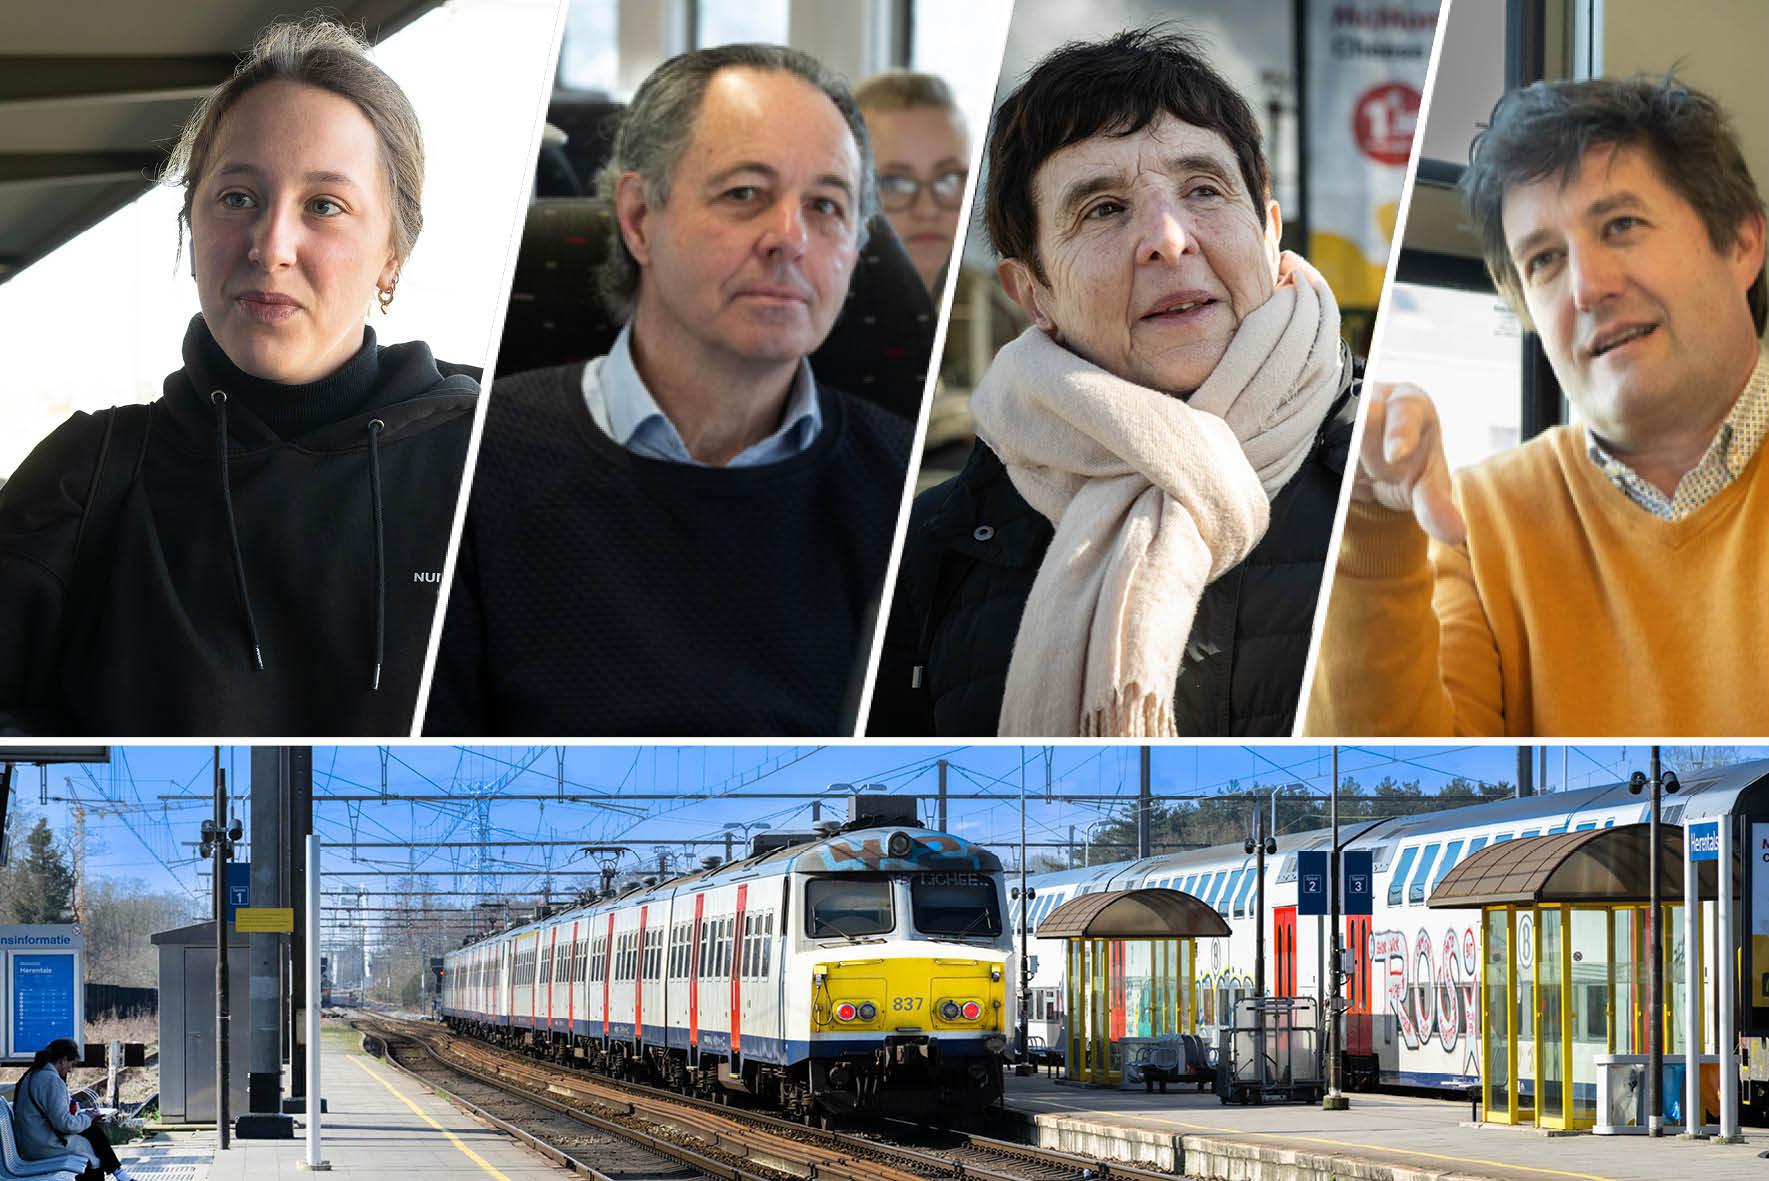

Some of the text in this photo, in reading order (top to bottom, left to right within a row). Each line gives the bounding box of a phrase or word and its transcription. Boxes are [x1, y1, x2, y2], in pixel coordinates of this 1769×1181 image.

[1308, 881, 1317, 892] 2
[1354, 881, 1363, 892] 3
[236, 892, 243, 903] 1
[0, 935, 71, 945] nsinformatie
[893, 997, 924, 1011] 837
